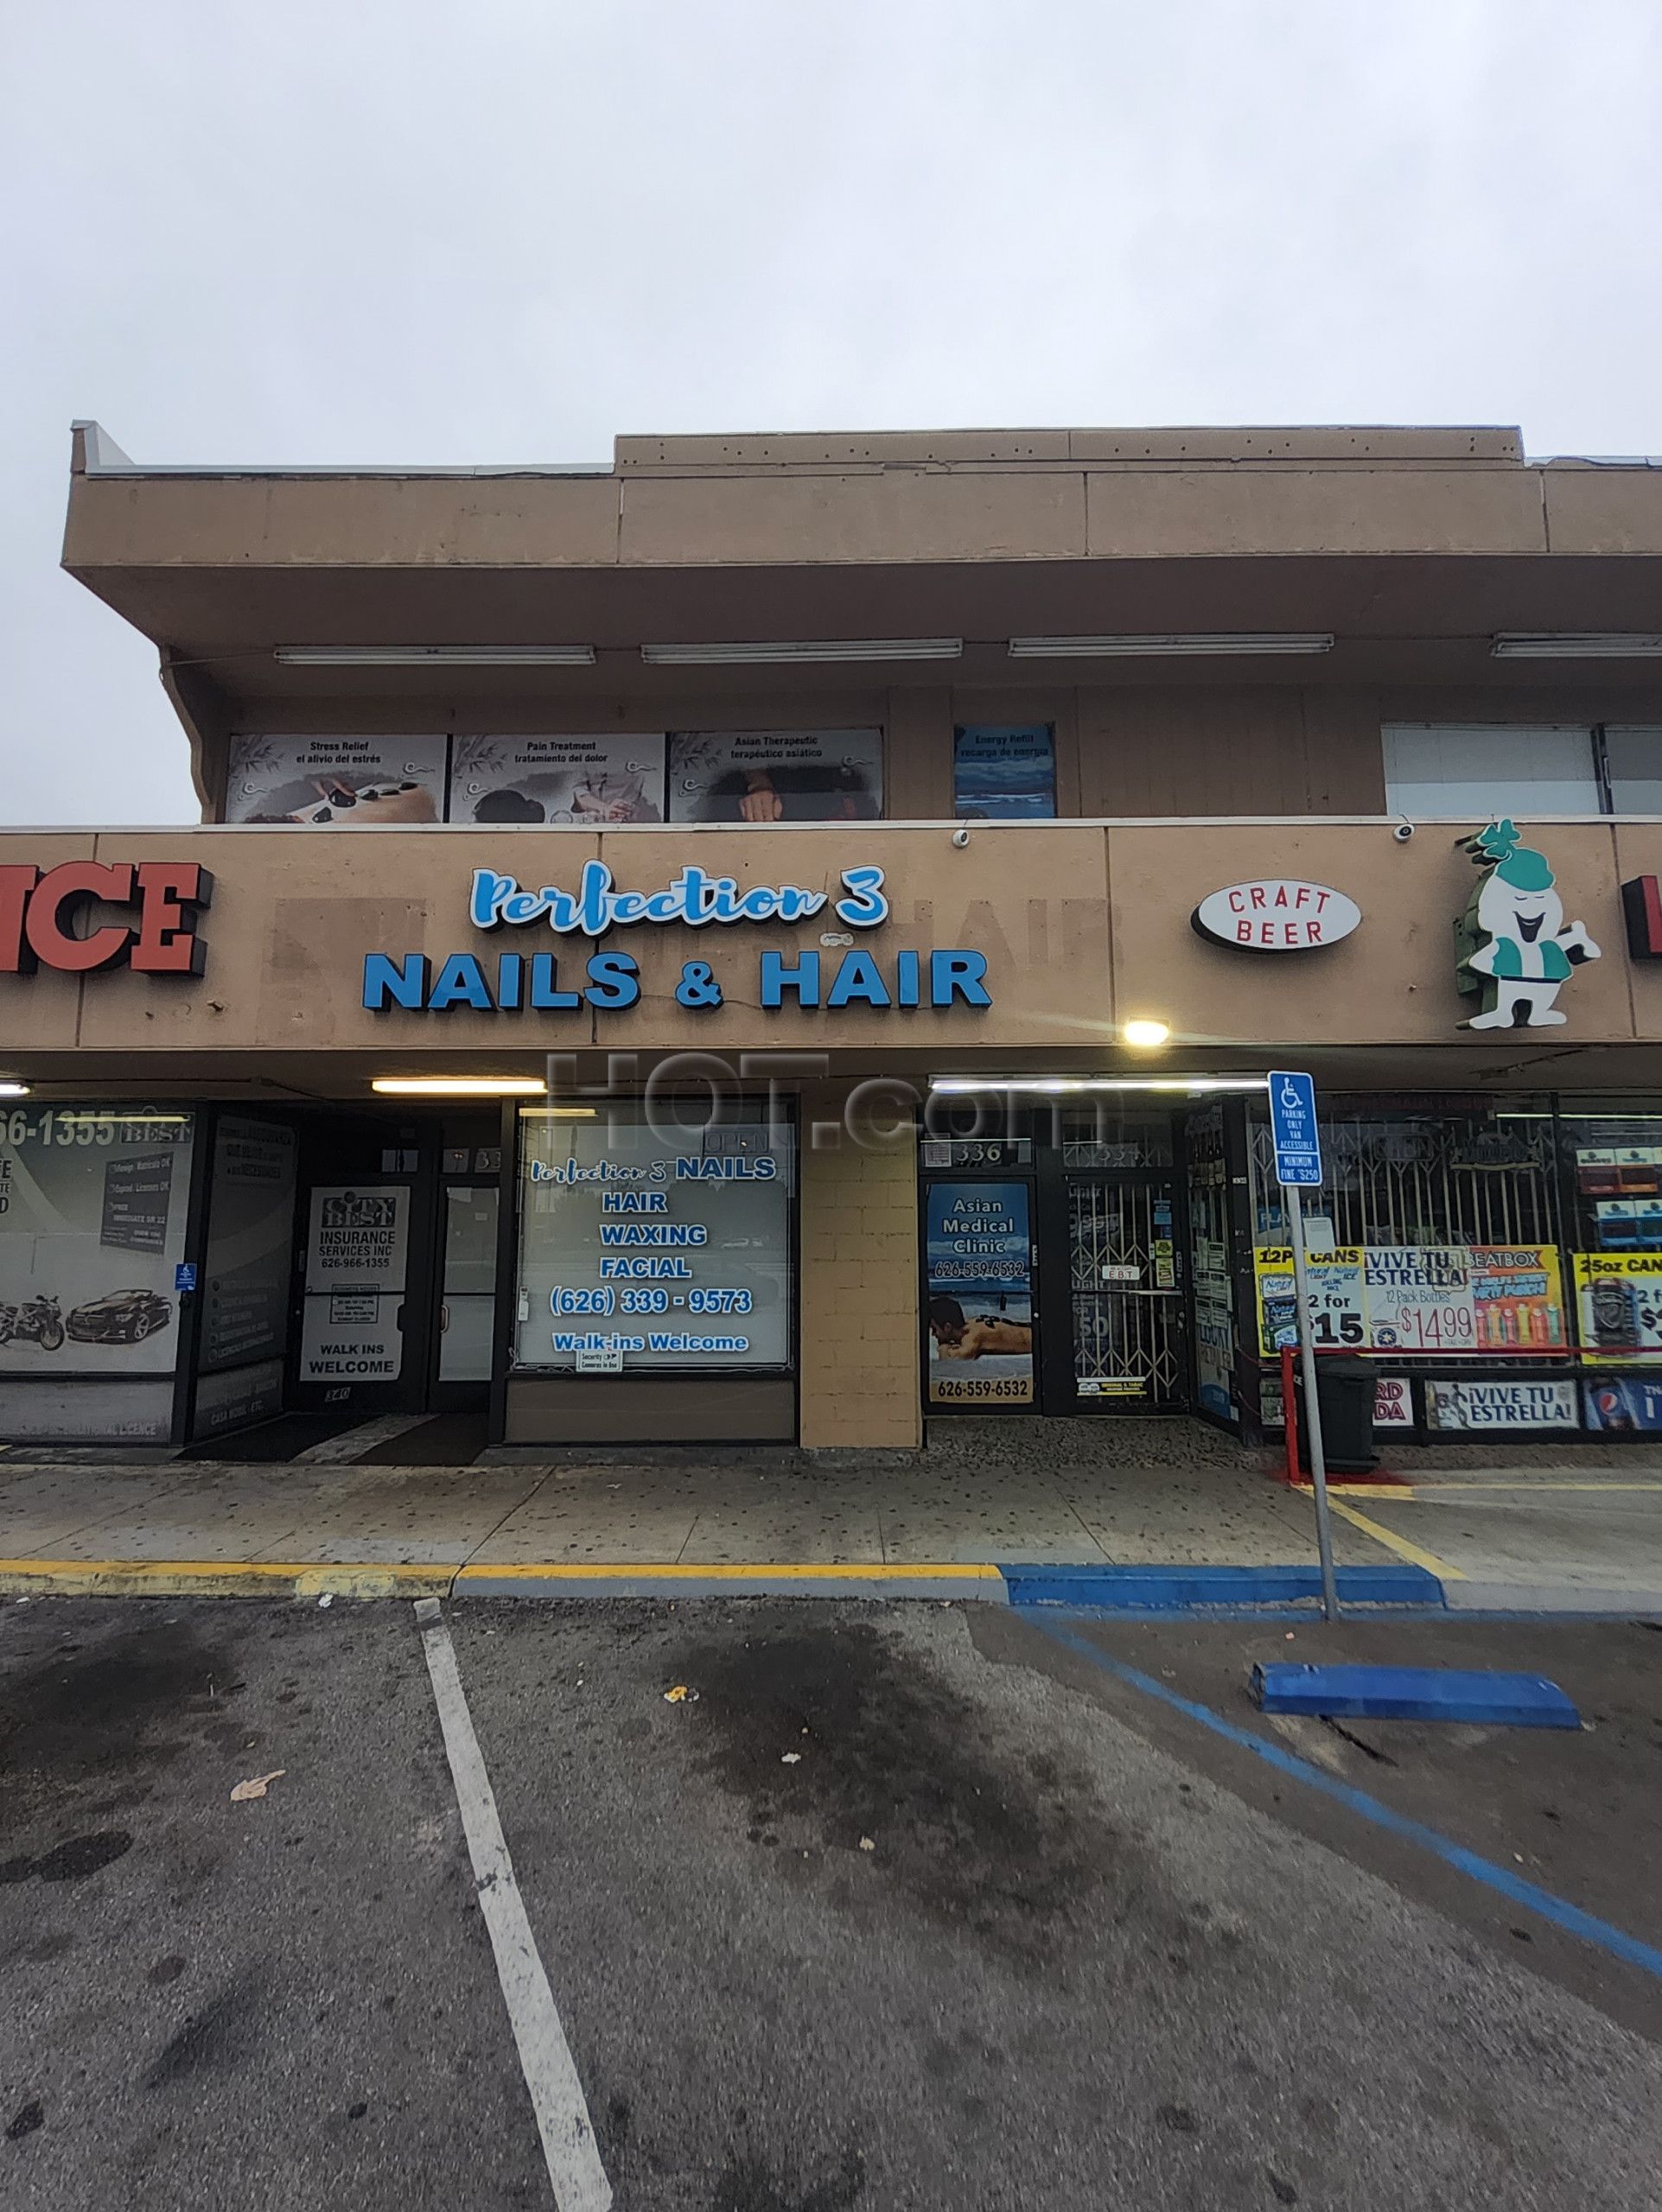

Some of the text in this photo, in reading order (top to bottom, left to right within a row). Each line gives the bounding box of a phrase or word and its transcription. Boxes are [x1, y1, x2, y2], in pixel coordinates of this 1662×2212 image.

[310, 741, 369, 751] Stress Relief
[526, 741, 596, 751] Pain Treatment
[735, 736, 818, 747] Asian Therapeutic
[296, 754, 381, 764] el alivio del estrés
[515, 754, 608, 763] tratamiento del dolor
[471, 859, 888, 938] Perfection 3
[1228, 886, 1331, 913] CRAFT
[1237, 920, 1321, 944] BEER
[362, 950, 994, 1011] NAILS & HAIR
[1281, 1109, 1306, 1120] PARKING
[1287, 1120, 1302, 1129] ONLY
[125, 1126, 190, 1142] BEST
[1289, 1130, 1302, 1139] VAN
[705, 1133, 767, 1151] OPEN
[1280, 1141, 1314, 1150] ACCESSIBLE
[956, 1143, 1001, 1161] 336
[1283, 1155, 1313, 1166] MINIMUM
[530, 1156, 777, 1185] Perfection 3 NAILS
[1281, 1168, 1319, 1180] FINE $250
[326, 1198, 394, 1213] CITY
[602, 1192, 669, 1213] HAIR
[953, 1198, 1003, 1212] Asian
[326, 1211, 393, 1227] BEST
[943, 1218, 1014, 1232] Medical
[320, 1230, 396, 1245] INSURANCE
[599, 1224, 708, 1247] WAXING
[319, 1246, 392, 1257] SERVICES INC
[953, 1239, 1008, 1254] Clinic
[322, 1258, 390, 1268] 626-966-1355
[599, 1256, 692, 1279] FACIAL
[935, 1261, 1025, 1279] 626-559-6532
[1580, 1259, 1622, 1273] 25oz
[550, 1286, 615, 1316] (626)
[620, 1288, 668, 1313] 339
[689, 1288, 752, 1314] 9573
[1309, 1294, 1351, 1308] 2 for
[1397, 1290, 1419, 1305] Pack
[1420, 1290, 1450, 1304] Bottles
[321, 1344, 385, 1355] WALK INS
[551, 1332, 750, 1352] Walk-ins Welcome
[582, 1352, 602, 1362] Security
[309, 1360, 394, 1374] WELCOME
[938, 1380, 1028, 1397] 626-559-6532
[1525, 1386, 1554, 1405] TU
[1471, 1404, 1572, 1422] ESTRELLA!
